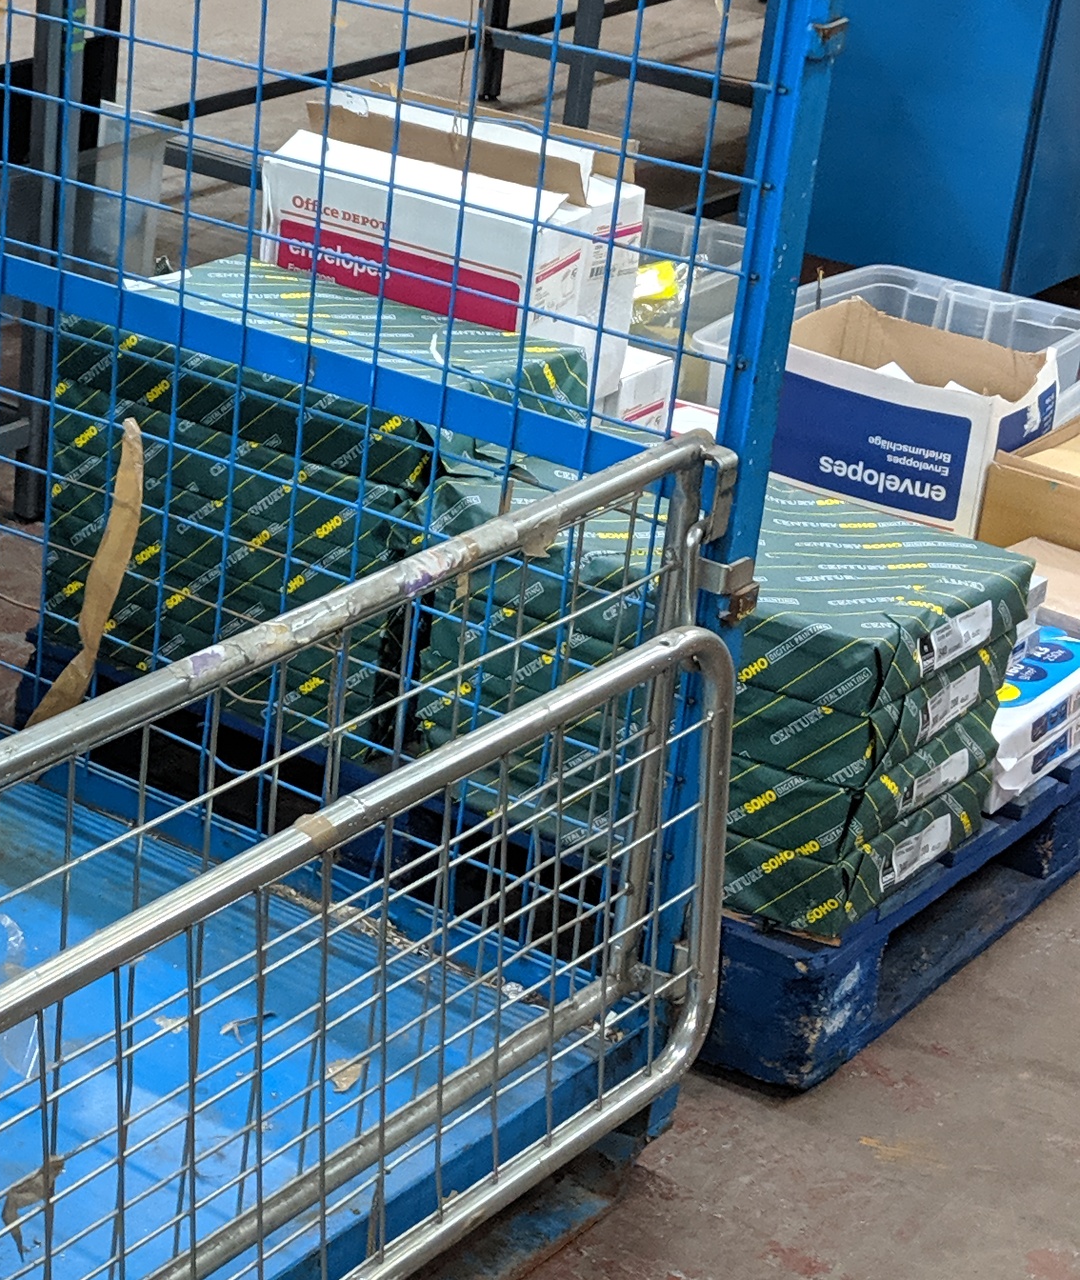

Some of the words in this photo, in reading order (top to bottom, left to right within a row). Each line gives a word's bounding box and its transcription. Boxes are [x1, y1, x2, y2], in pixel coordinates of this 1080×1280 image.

[292, 195, 339, 218] Offce
[341, 210, 387, 231] DEPOT
[145, 379, 171, 403] SOHO
[74, 426, 98, 448] SOHO
[868, 436, 952, 463] Briefumschläge
[887, 454, 950, 476] Enveloppes
[819, 456, 946, 501] envelopes
[315, 515, 342, 539] SOHO
[795, 574, 858, 583] CENTUR
[887, 562, 928, 570] SOHO
[860, 622, 896, 630] CENT
[738, 657, 768, 683] SOHO
[768, 641, 796, 662] DIGITAL
[794, 623, 831, 646] PRINTING
[838, 671, 870, 696] PRINTING
[770, 707, 822, 746] CENTURY
[744, 790, 777, 814] SOHO
[777, 776, 806, 796] DIGITAL
[723, 866, 763, 898] NTURY
[762, 850, 795, 874] SOHO
[806, 898, 839, 924] SOHO
